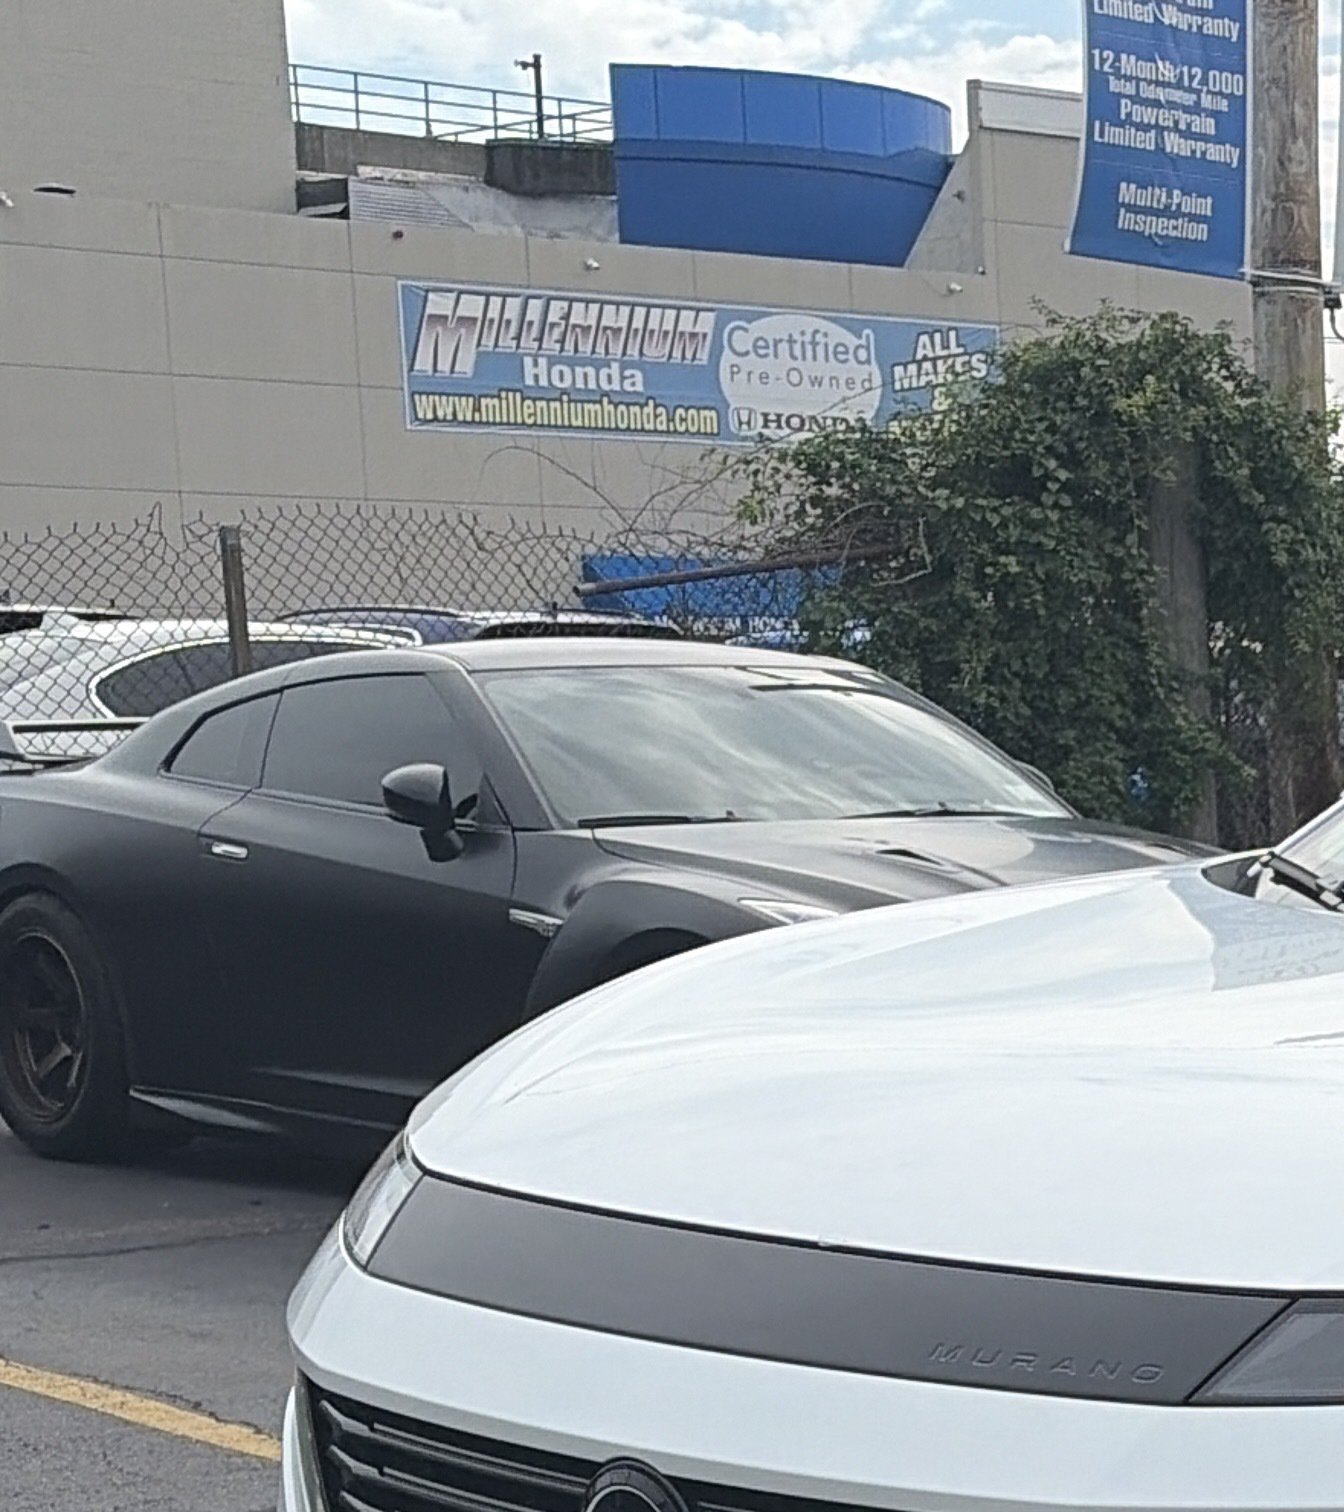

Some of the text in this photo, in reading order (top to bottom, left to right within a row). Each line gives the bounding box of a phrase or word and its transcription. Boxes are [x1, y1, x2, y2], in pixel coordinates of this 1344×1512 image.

[1162, 3, 1240, 42] Warranty
[1108, 76, 1136, 96] Total
[1200, 92, 1230, 113] Mile
[1120, 98, 1217, 135] Powertrain
[1094, 118, 1241, 169] Limited Warranty
[1118, 181, 1214, 218] Multi-Point
[1117, 207, 1209, 243] Inspection
[726, 324, 873, 367] Certified
[914, 327, 965, 361] ALL
[523, 356, 645, 393] Honda
[729, 362, 874, 392] Pre-Owned
[893, 353, 989, 392] MAKES
[412, 388, 720, 436] www.millenniumhonda.com
[928, 1342, 1165, 1384] MURANO
